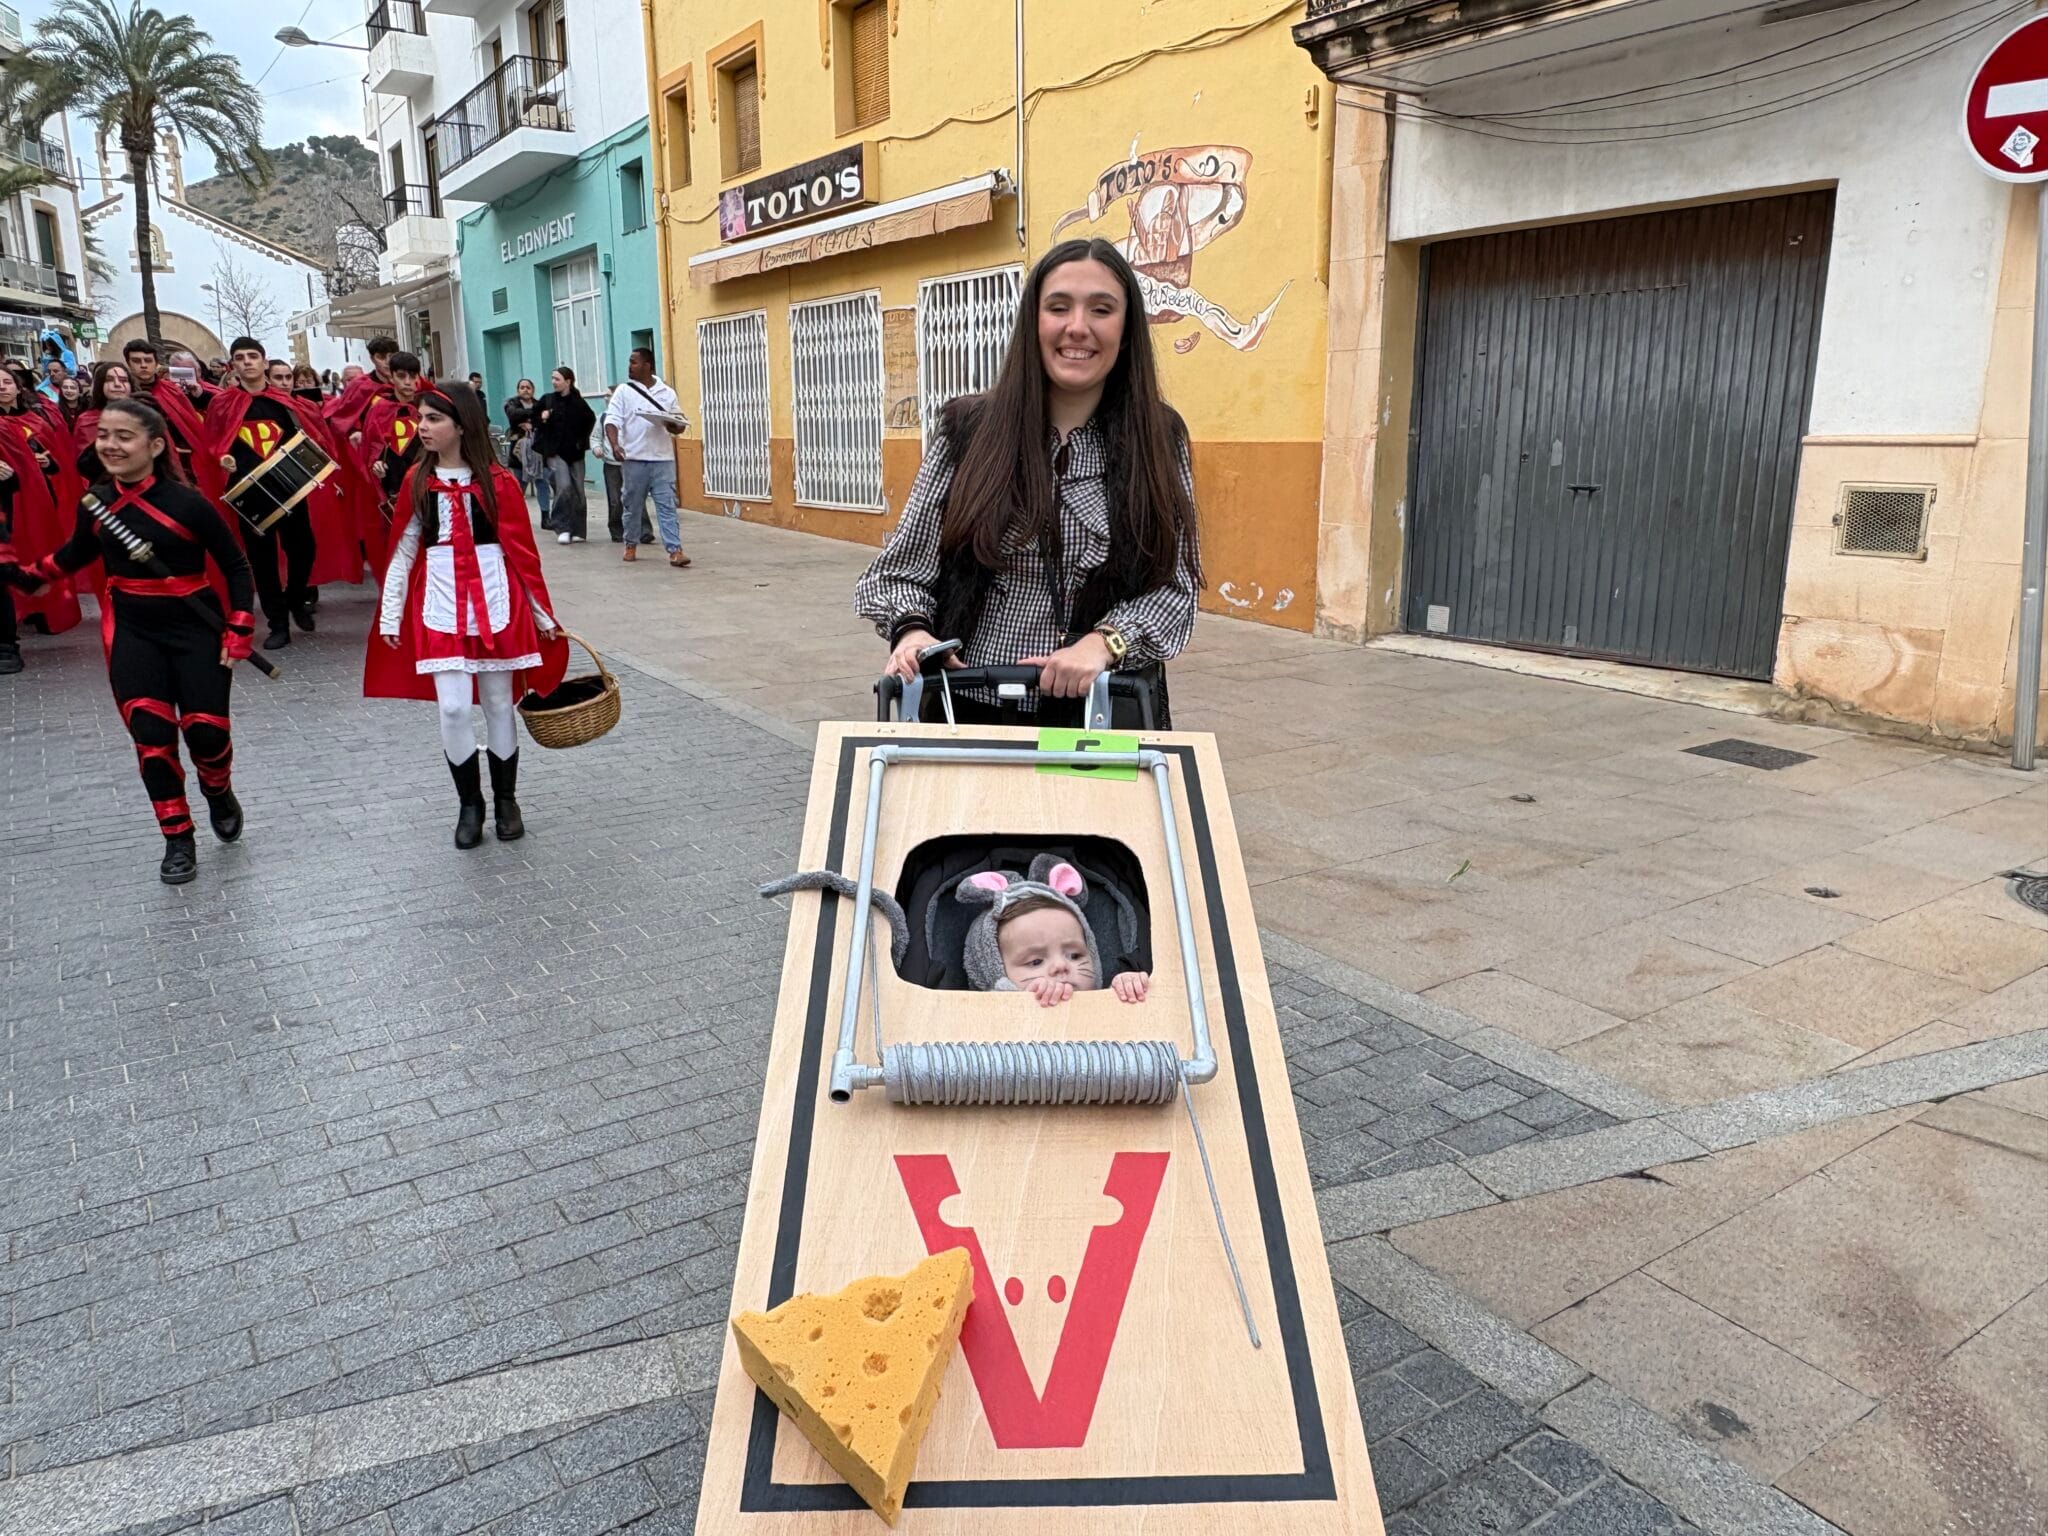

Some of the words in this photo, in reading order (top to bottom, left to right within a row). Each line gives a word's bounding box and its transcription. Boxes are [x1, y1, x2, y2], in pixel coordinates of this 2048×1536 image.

[747, 164, 861, 226] TOTO'S
[1099, 153, 1173, 203] TOTO'S
[500, 240, 517, 264] EL
[517, 212, 576, 257] CONVENT
